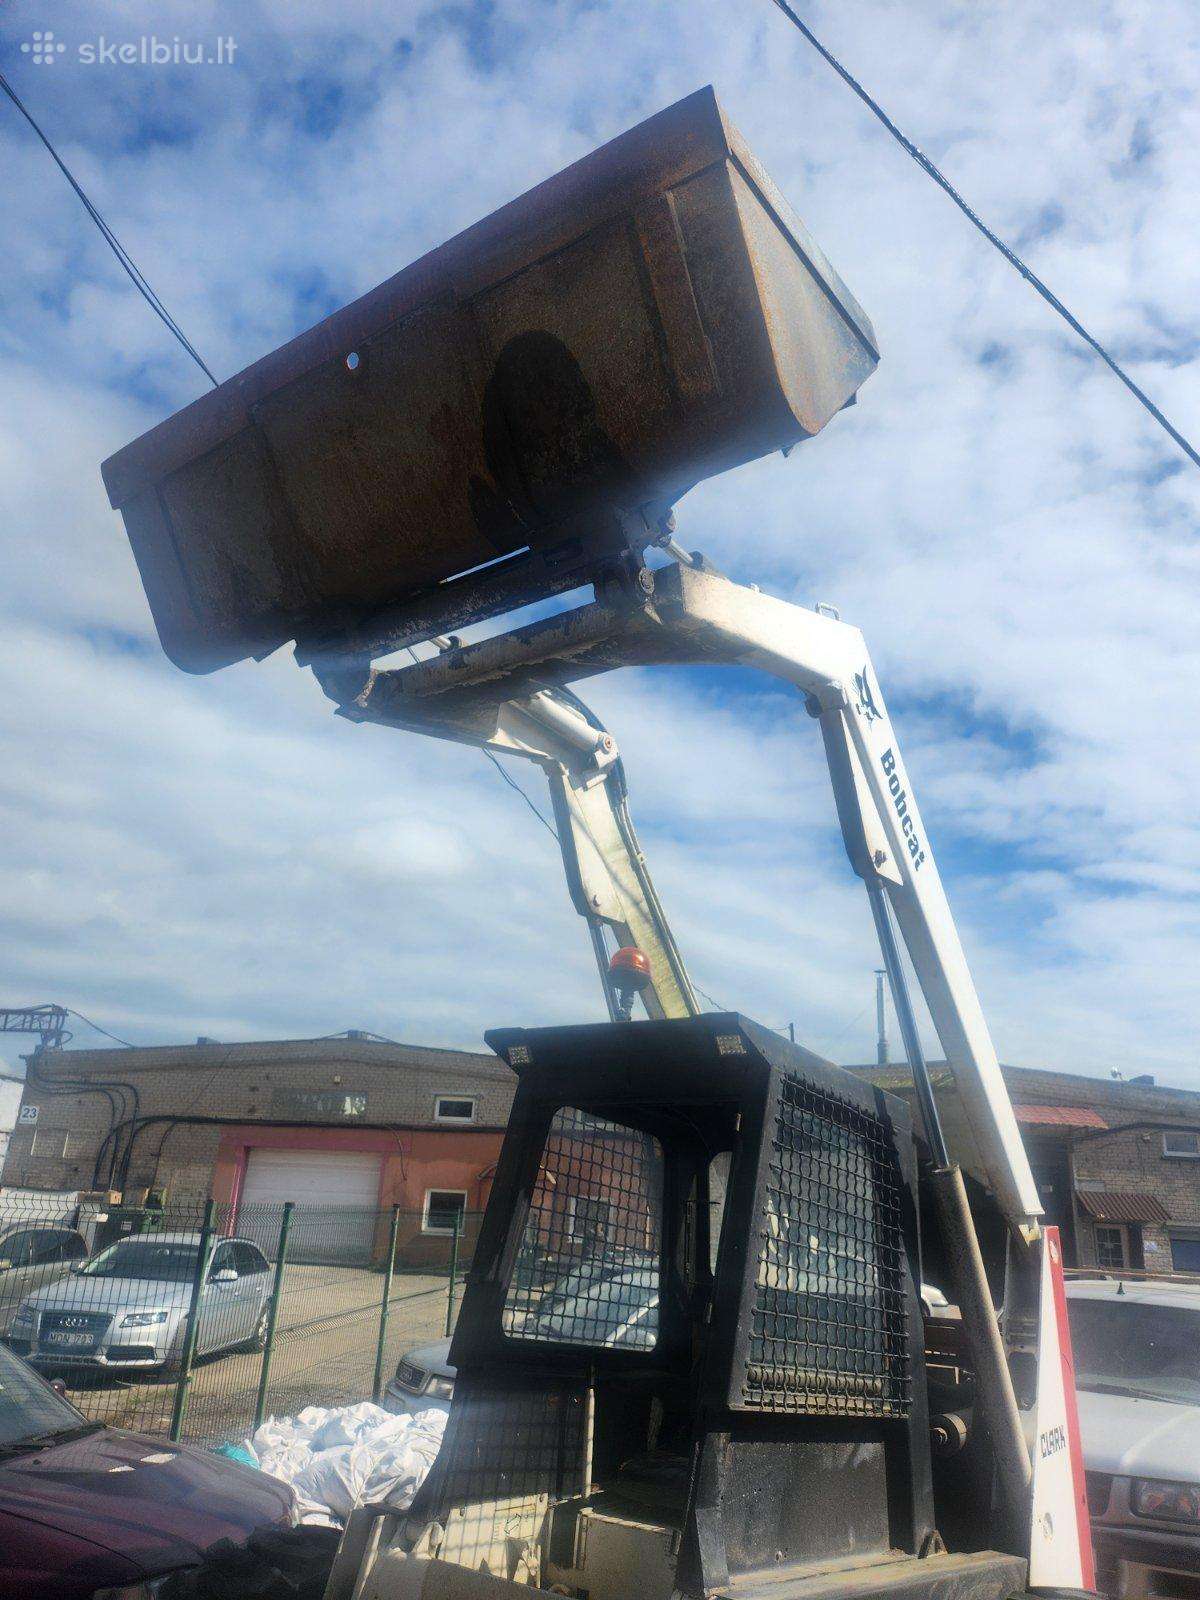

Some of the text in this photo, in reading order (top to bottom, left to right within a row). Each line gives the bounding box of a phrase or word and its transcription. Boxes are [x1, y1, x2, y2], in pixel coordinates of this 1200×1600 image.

[881, 748, 925, 872] Bobcat
[22, 1107, 37, 1119] 23
[1040, 1425, 1066, 1458] CLARK
